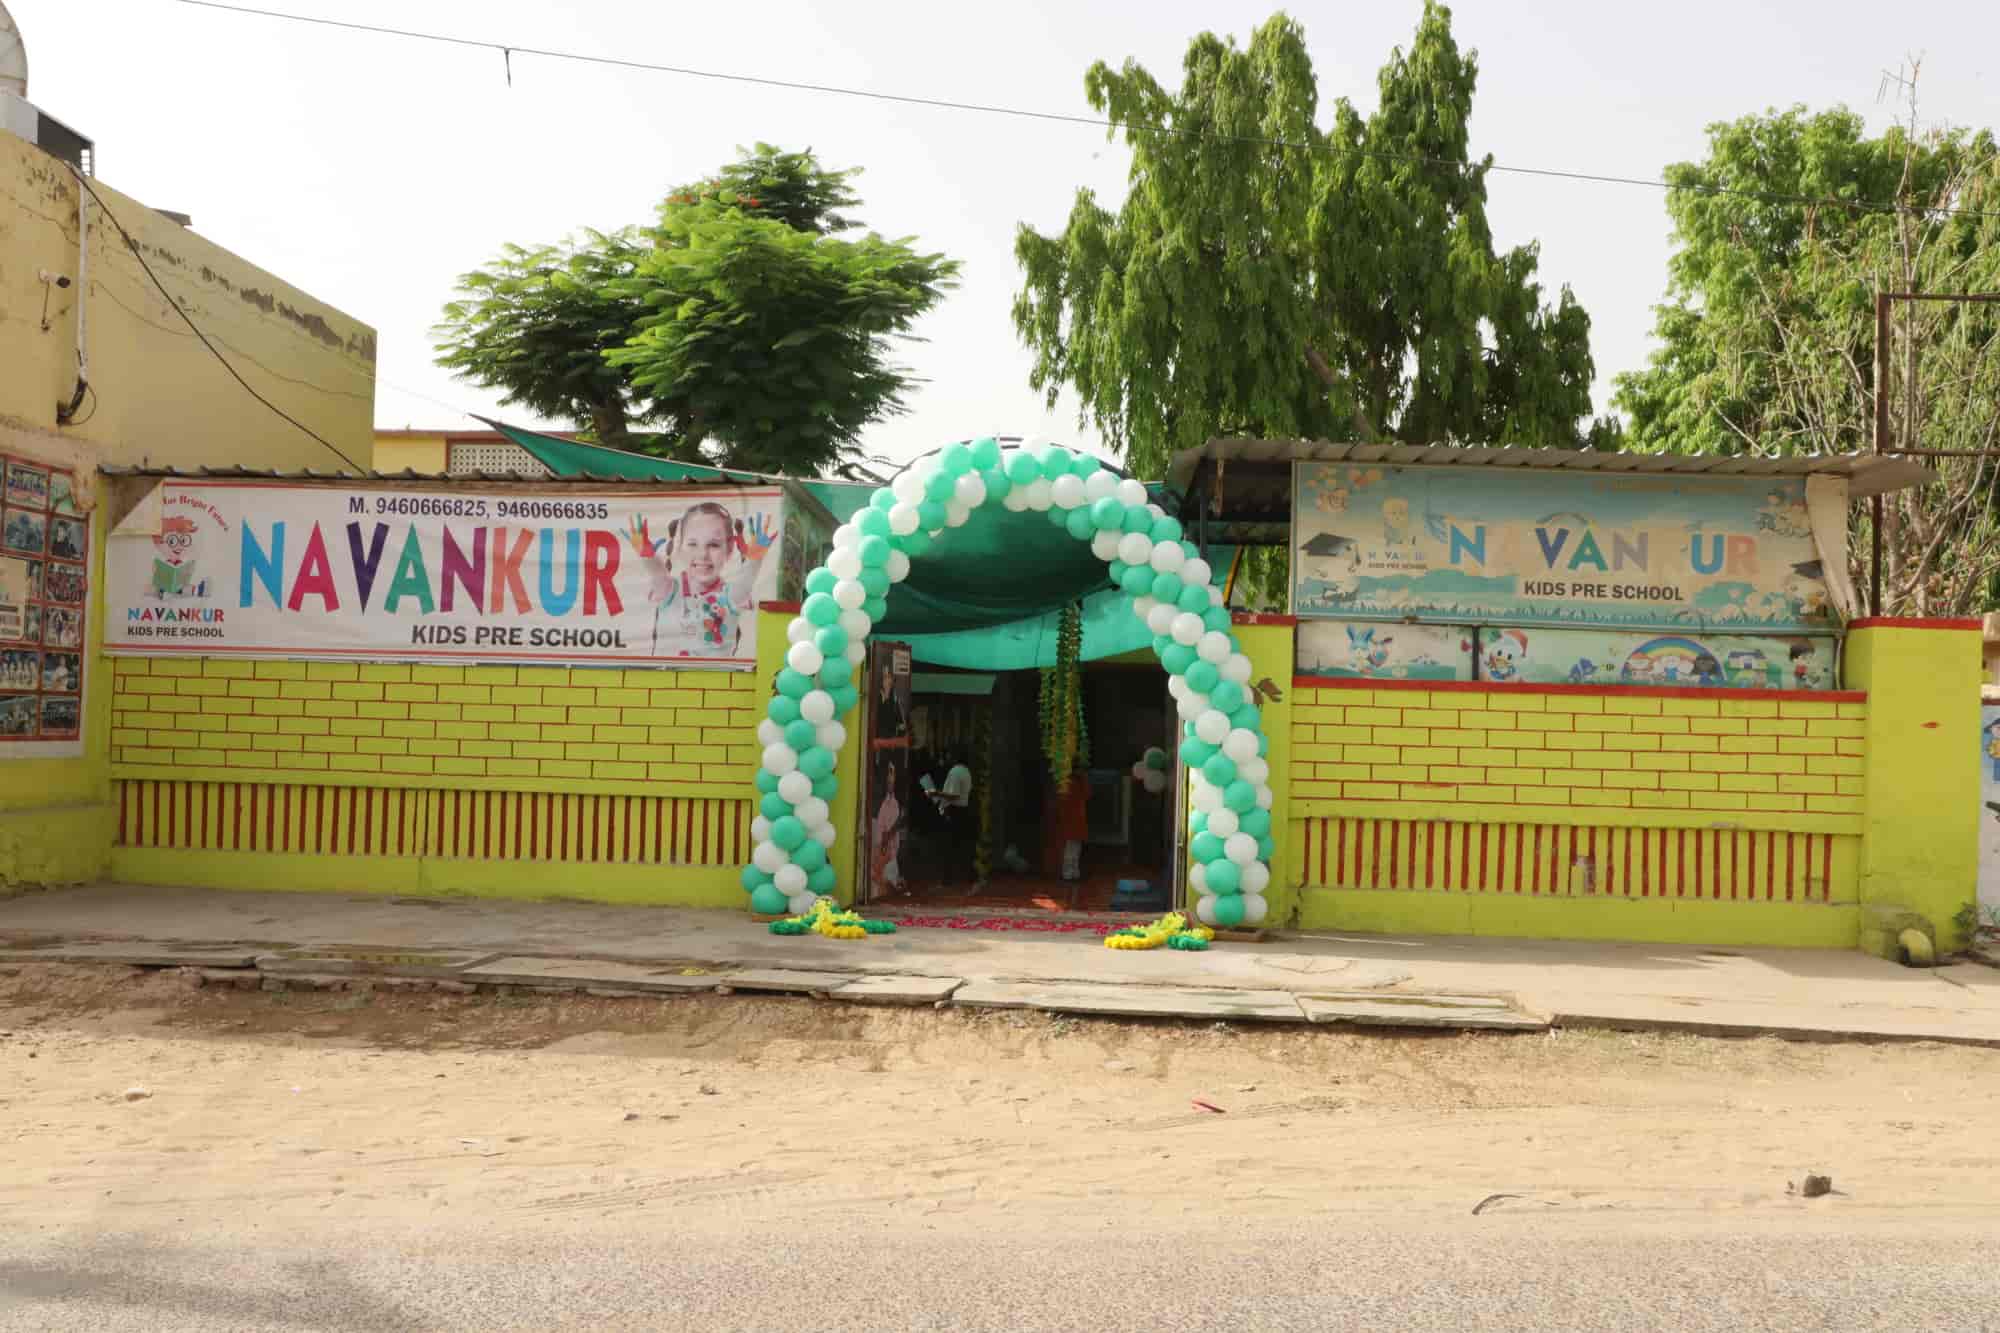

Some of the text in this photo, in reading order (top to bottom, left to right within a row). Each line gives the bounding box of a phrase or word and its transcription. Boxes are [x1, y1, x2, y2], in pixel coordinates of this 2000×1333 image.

[349, 496, 609, 520] M. 9460666825, 9460666835
[239, 519, 625, 617] NAVANKUR
[1524, 580, 1684, 601] KIDS PRE SCHOOL
[127, 607, 225, 622] NAVANKUR
[127, 626, 225, 638] KIDS PRE SCHOOL
[411, 624, 628, 649] KIDS PRE SCHOOL
